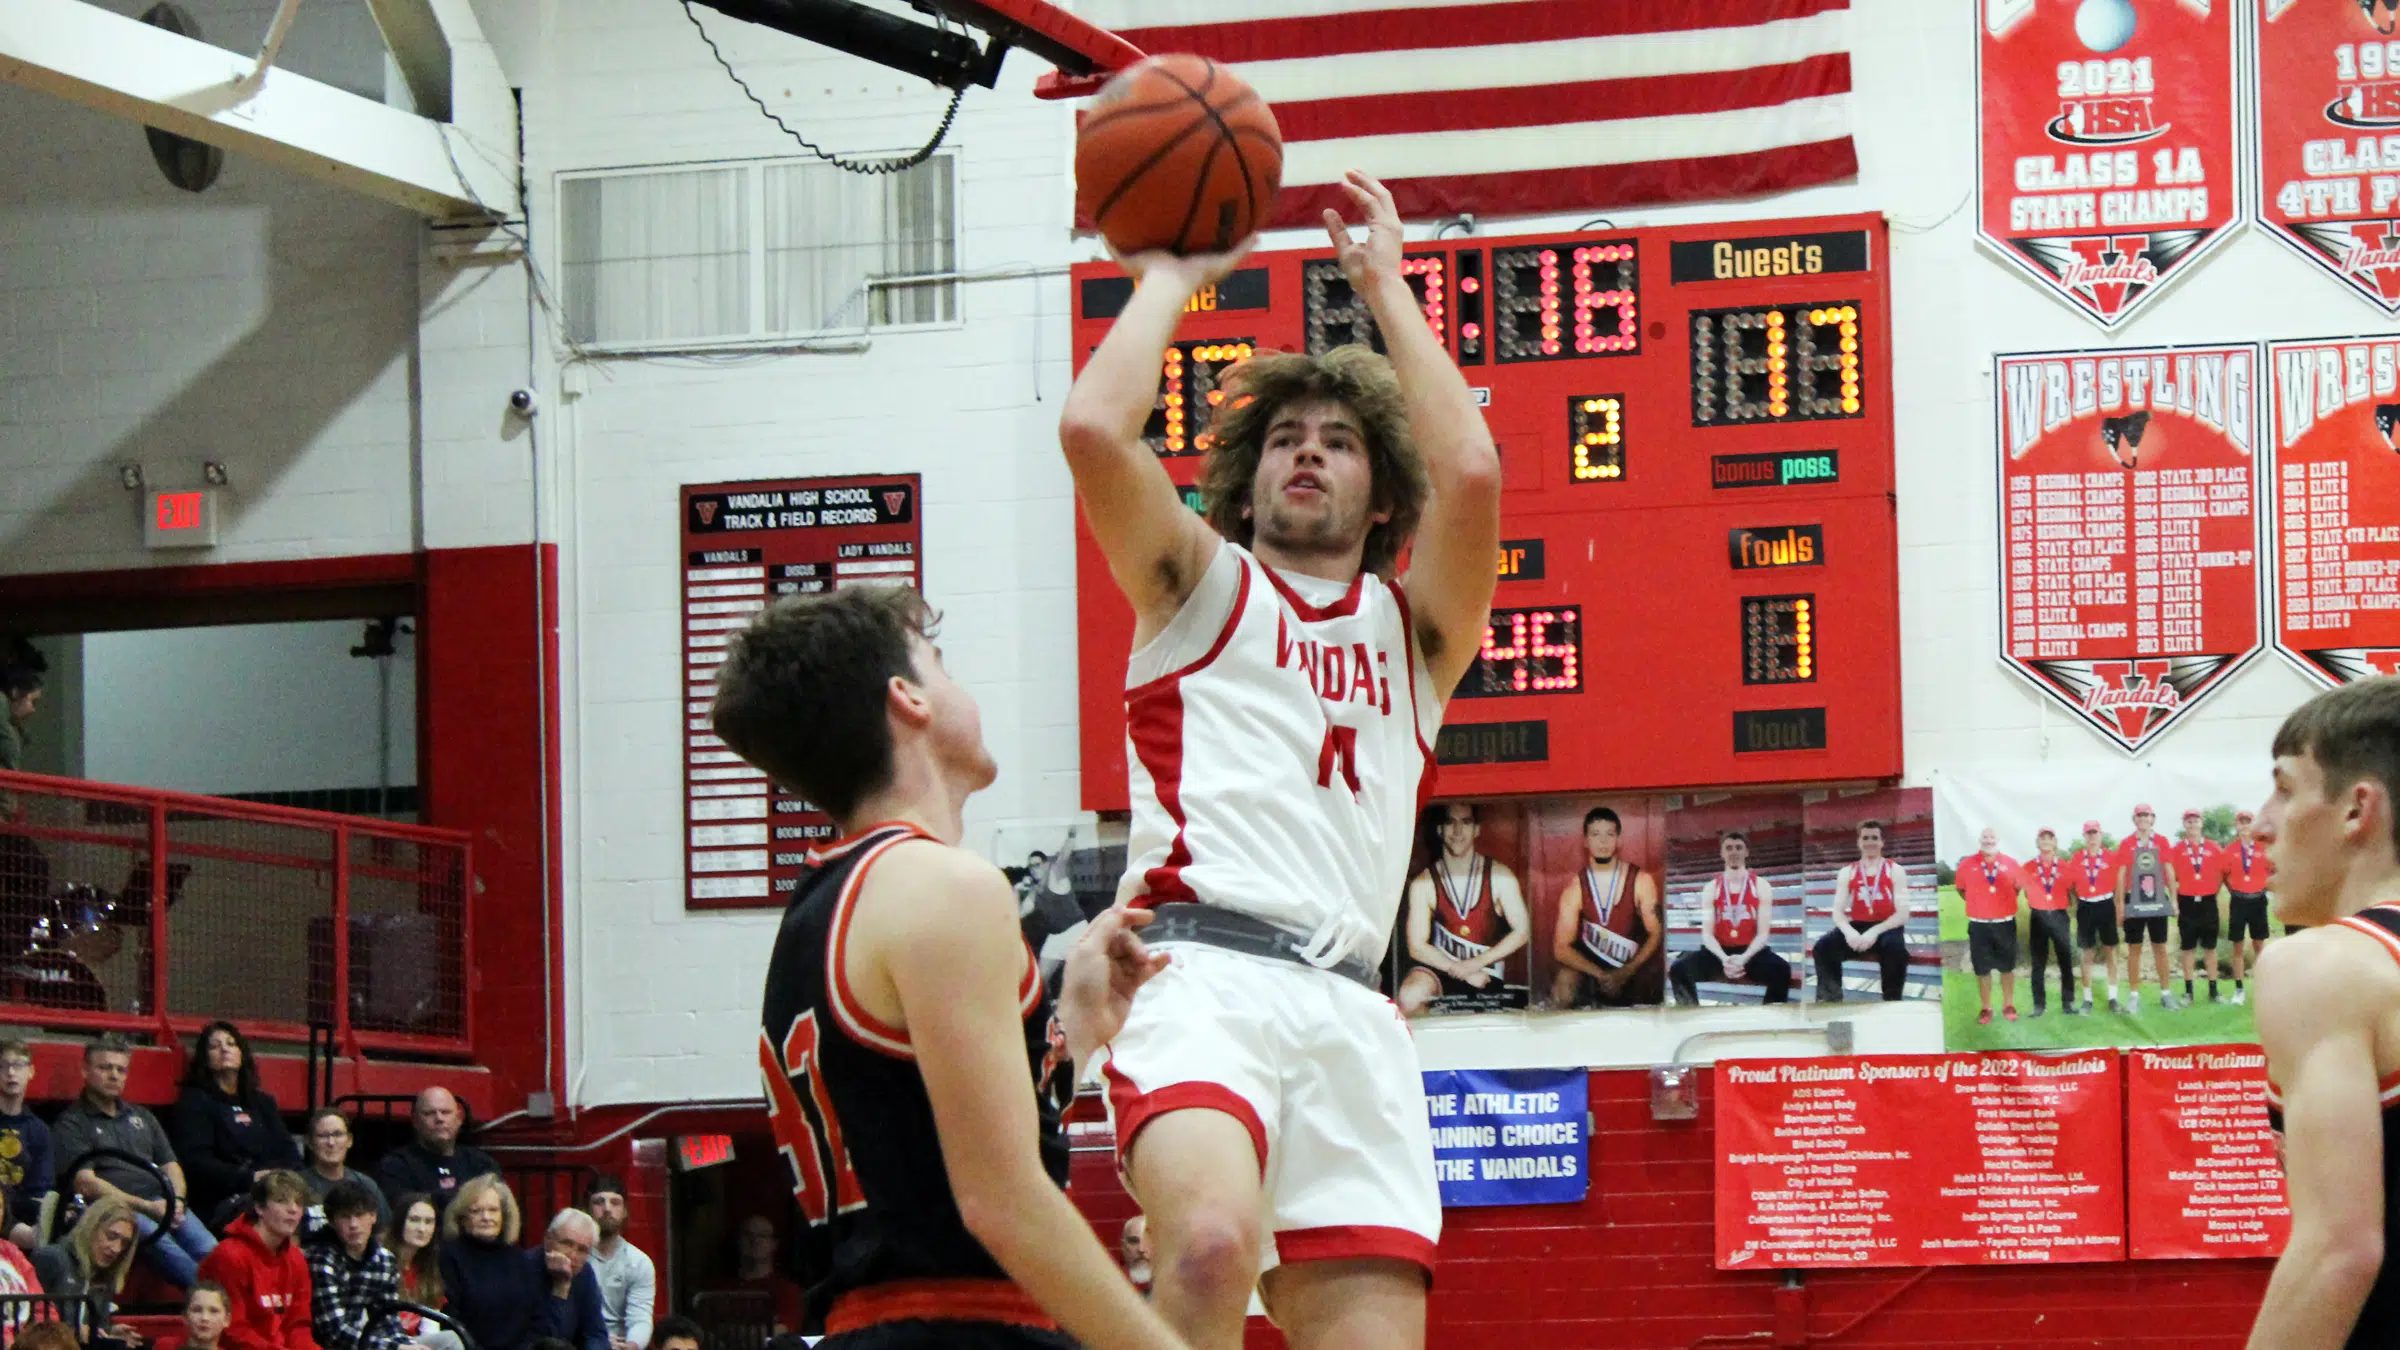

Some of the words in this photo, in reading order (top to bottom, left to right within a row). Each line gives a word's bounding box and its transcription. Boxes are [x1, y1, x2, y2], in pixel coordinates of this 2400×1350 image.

[2057, 56, 2155, 97] 2021
[2015, 151, 2138, 191] CLASS
[2153, 147, 2204, 184] 1A
[2277, 178, 2360, 217] 4TH
[2010, 194, 2096, 230] STATE
[2101, 187, 2208, 226] CHAMPS
[1713, 241, 1822, 279] Guests
[2061, 256, 2158, 288] Vandals
[2276, 345, 2400, 448] WRES
[2006, 352, 2252, 460] WRESTLING
[1574, 398, 1621, 479] 2
[1715, 457, 1774, 484] bonus
[1781, 455, 1837, 484] poss.
[2160, 469, 2193, 485] STATE
[2215, 467, 2247, 482] PLACE
[2085, 472, 2125, 488] CHAMPS
[728, 493, 784, 509] VANDALIA
[790, 491, 819, 506] HIGH
[825, 489, 872, 505] SCHOOL
[2085, 489, 2125, 504] CHAMPS
[2210, 484, 2248, 499] CHAMPS
[724, 514, 763, 529] TRACK
[767, 512, 776, 528] &
[780, 511, 816, 527] FIELD
[821, 508, 877, 525] RECORDS
[2085, 506, 2125, 521] CHAMPS
[2086, 522, 2126, 537] CHAMPS
[2311, 530, 2342, 545] STATE
[2368, 526, 2400, 542] PLACE
[703, 550, 748, 563] VANDALS
[838, 545, 863, 557] LADY
[868, 543, 912, 556] VANDALS
[1740, 529, 1813, 566] fouls
[2037, 541, 2070, 556] STATE
[2094, 539, 2126, 554] PLACE
[2037, 558, 2070, 573] STATE
[2072, 556, 2111, 572] CHAMPS
[2162, 553, 2194, 568] STATE
[2312, 563, 2342, 578] STATE
[2037, 575, 2070, 590] STATE
[2095, 572, 2126, 588] PLACE
[2312, 580, 2342, 595] STATE
[2366, 577, 2398, 593] PLACE
[2087, 623, 2127, 638] CHAMPS
[2084, 682, 2179, 711] Vandals
[1748, 717, 1810, 748] bout
[804, 826, 832, 837] RELAY
[2142, 1053, 2193, 1069] Proud
[1728, 1065, 1776, 1083] Proud
[1780, 1065, 1855, 1082] Platinum
[1858, 1062, 1929, 1084] Sponsors
[1935, 1061, 1951, 1082] of
[1952, 1060, 1977, 1077] the
[1980, 1058, 2018, 1076] 2022
[1814, 1088, 1845, 1097] Electric
[2060, 1082, 2078, 1091] LLC
[1426, 1094, 1457, 1116] THE
[1464, 1092, 1559, 1115] ATHLETIC
[2034, 1109, 2055, 1117] Bank
[1431, 1126, 1496, 1148] AINING
[1502, 1122, 1578, 1146] CHOICE
[1834, 1126, 1865, 1134] Church
[1436, 1159, 1474, 1181] THE
[1481, 1155, 1577, 1180] VANDALS
[2260, 1180, 2278, 1189] LTD
[2047, 1211, 2077, 1220] Course
[1880, 1238, 1897, 1247] LLC
